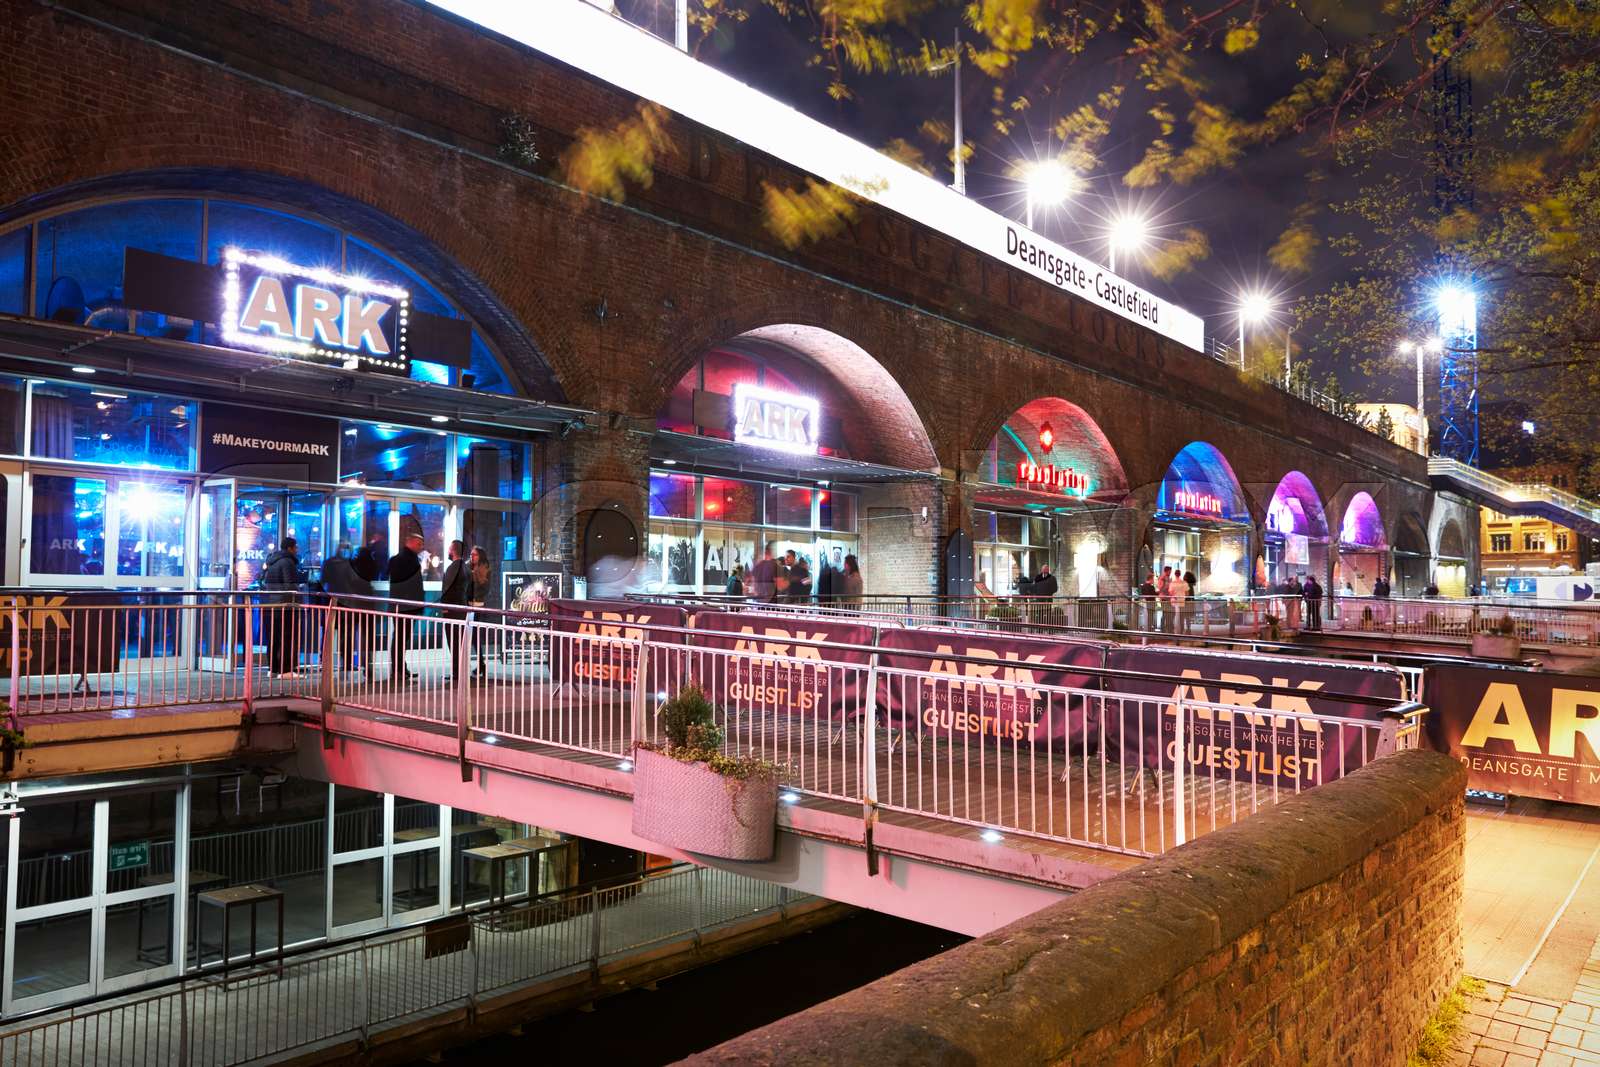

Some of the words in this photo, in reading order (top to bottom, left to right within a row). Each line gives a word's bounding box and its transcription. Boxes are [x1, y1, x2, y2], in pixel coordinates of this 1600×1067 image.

[240, 275, 392, 355] ARK
[742, 398, 810, 446] ARK
[1018, 462, 1090, 491] revolution
[50, 538, 87, 552] ARK
[133, 540, 169, 553] ARK
[237, 549, 264, 560] ARK
[574, 610, 652, 649] ARK
[730, 625, 829, 673] ARK
[924, 644, 1046, 700] ARK
[1165, 669, 1326, 733] ARK
[923, 707, 1039, 742] GUESTLIST
[1165, 721, 1231, 740] DENSGATE
